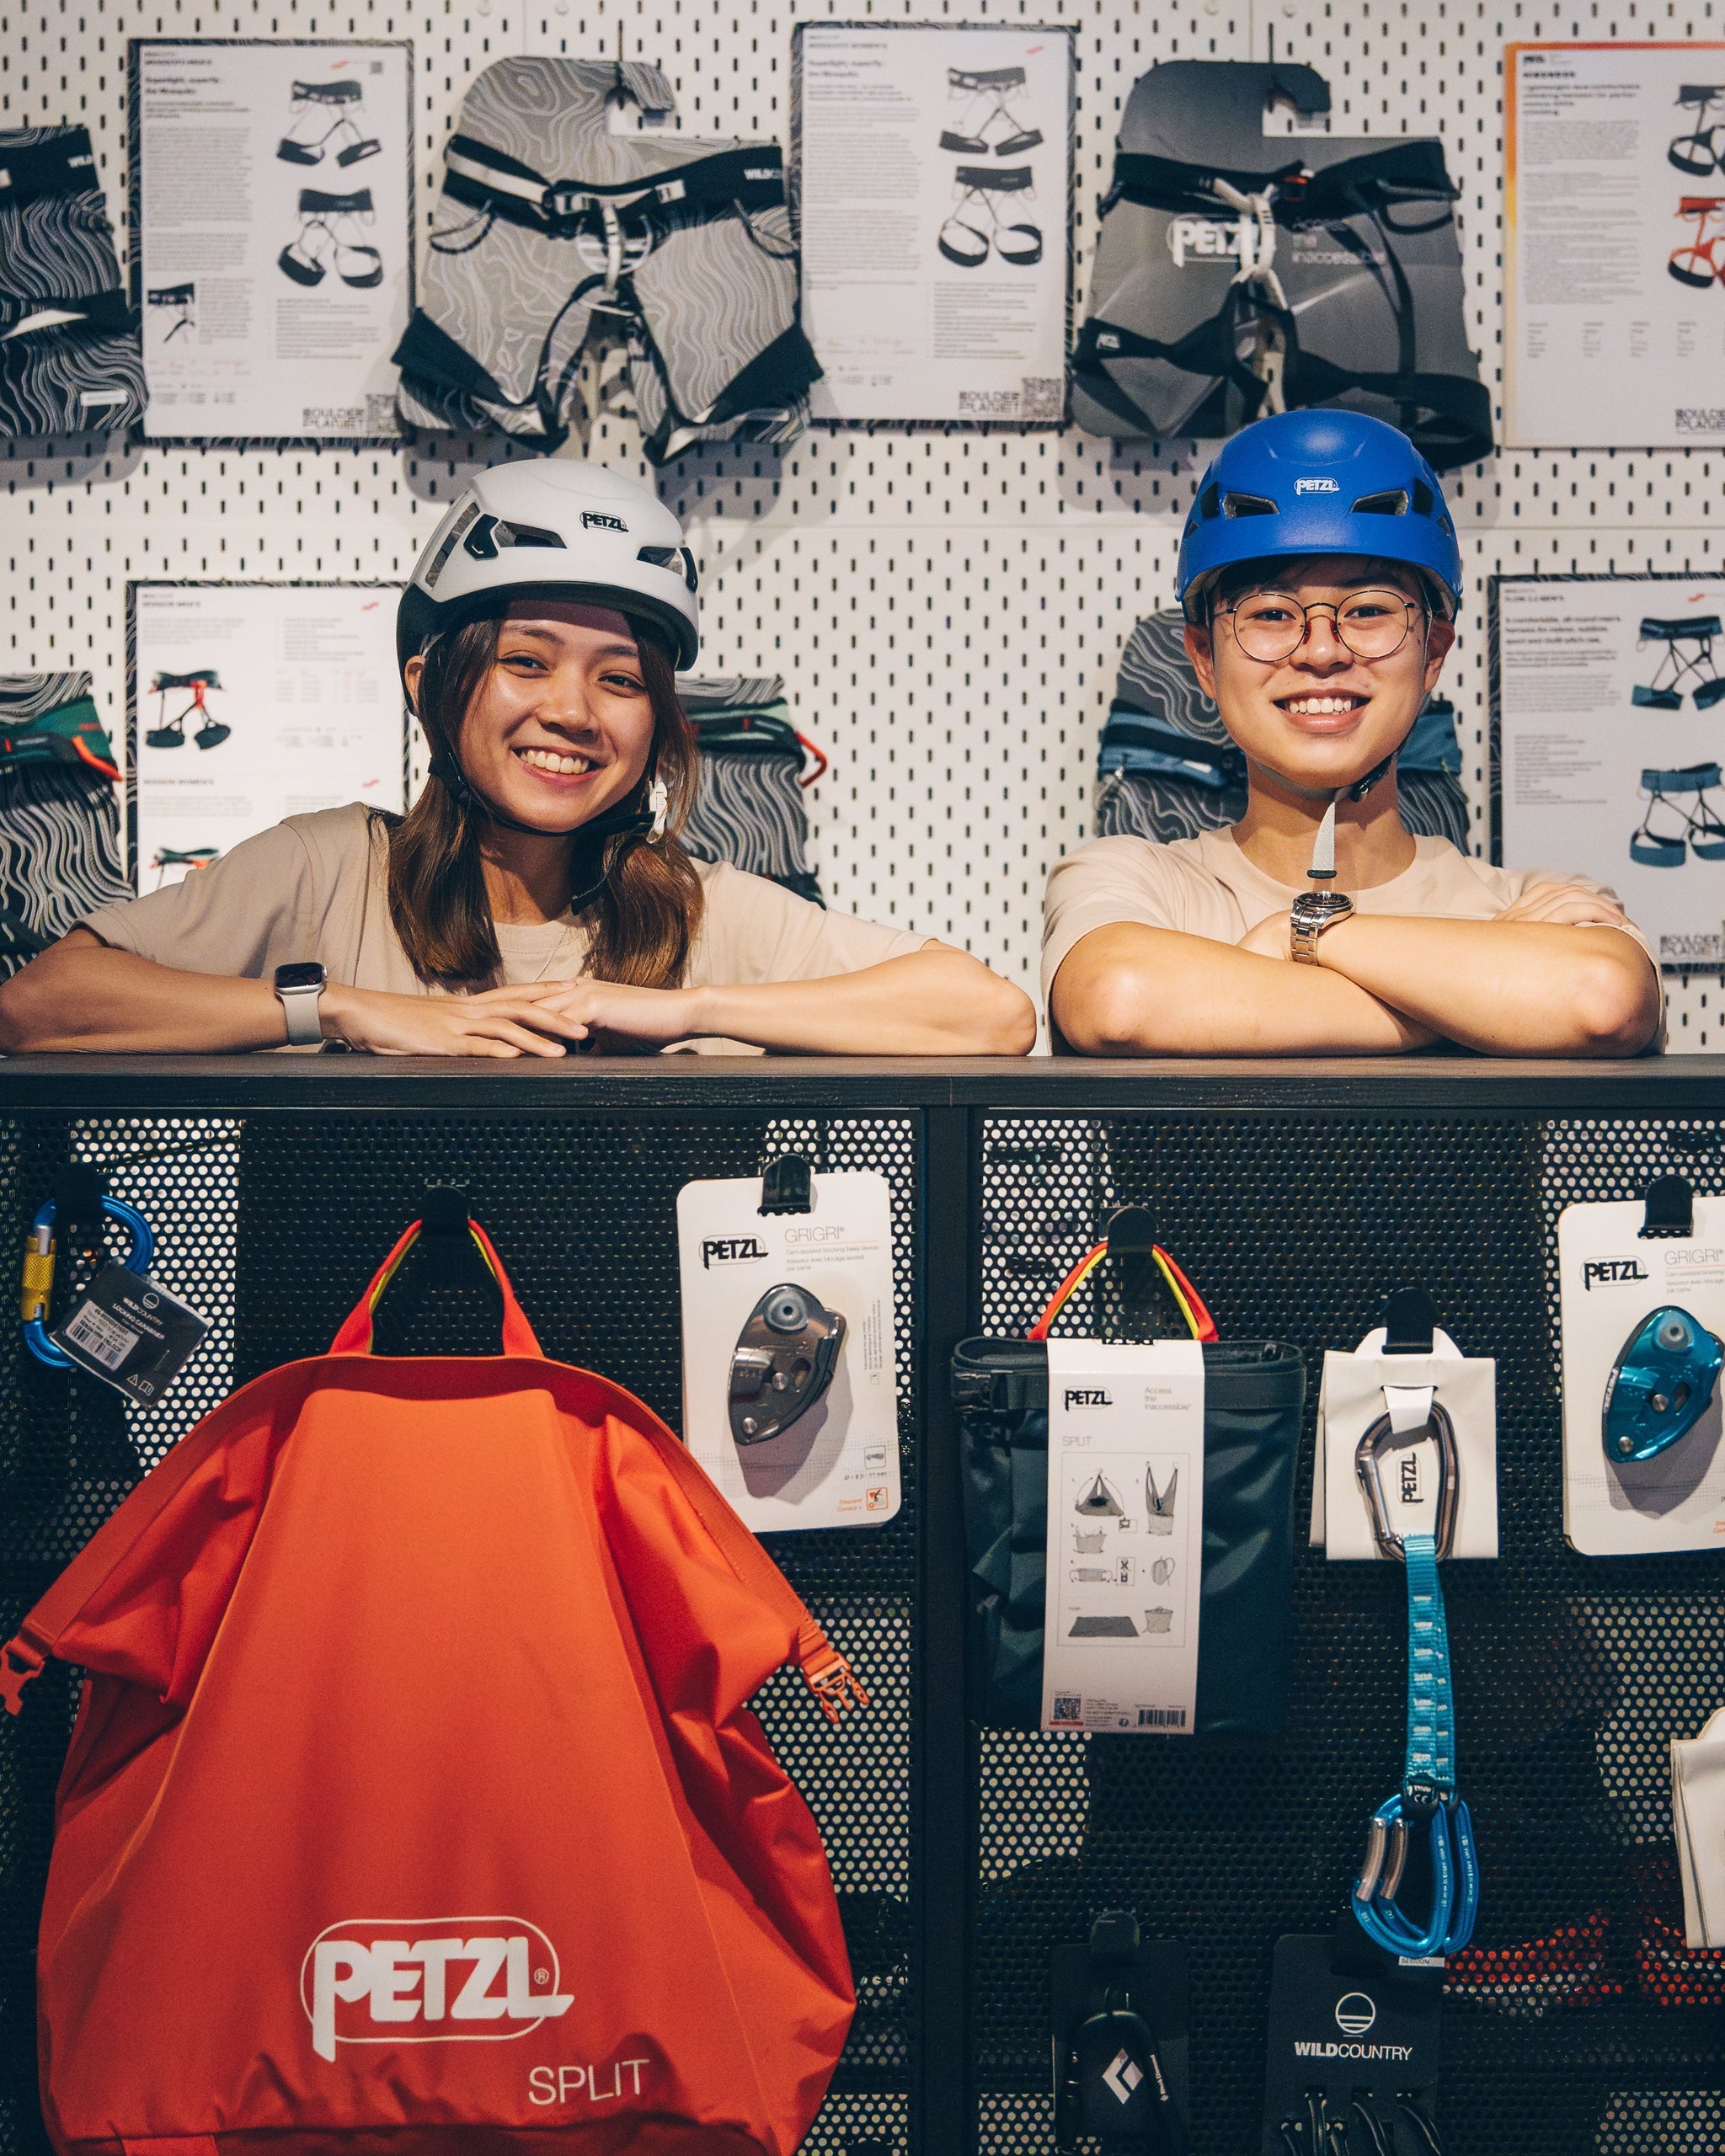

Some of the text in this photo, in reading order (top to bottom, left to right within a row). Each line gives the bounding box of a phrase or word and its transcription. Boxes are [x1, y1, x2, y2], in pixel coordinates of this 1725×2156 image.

[1296, 479, 1341, 496] PETZL
[582, 511, 630, 532] PETZL
[702, 1238, 769, 1271] PETZL
[1583, 1260, 1649, 1292] PETZL
[1065, 1390, 1113, 1412] PETZL
[1401, 1451, 1424, 1503] PETZL
[1294, 2041, 1413, 2062] WILDCOUNTRY
[528, 2057, 651, 2106] SPLIT
